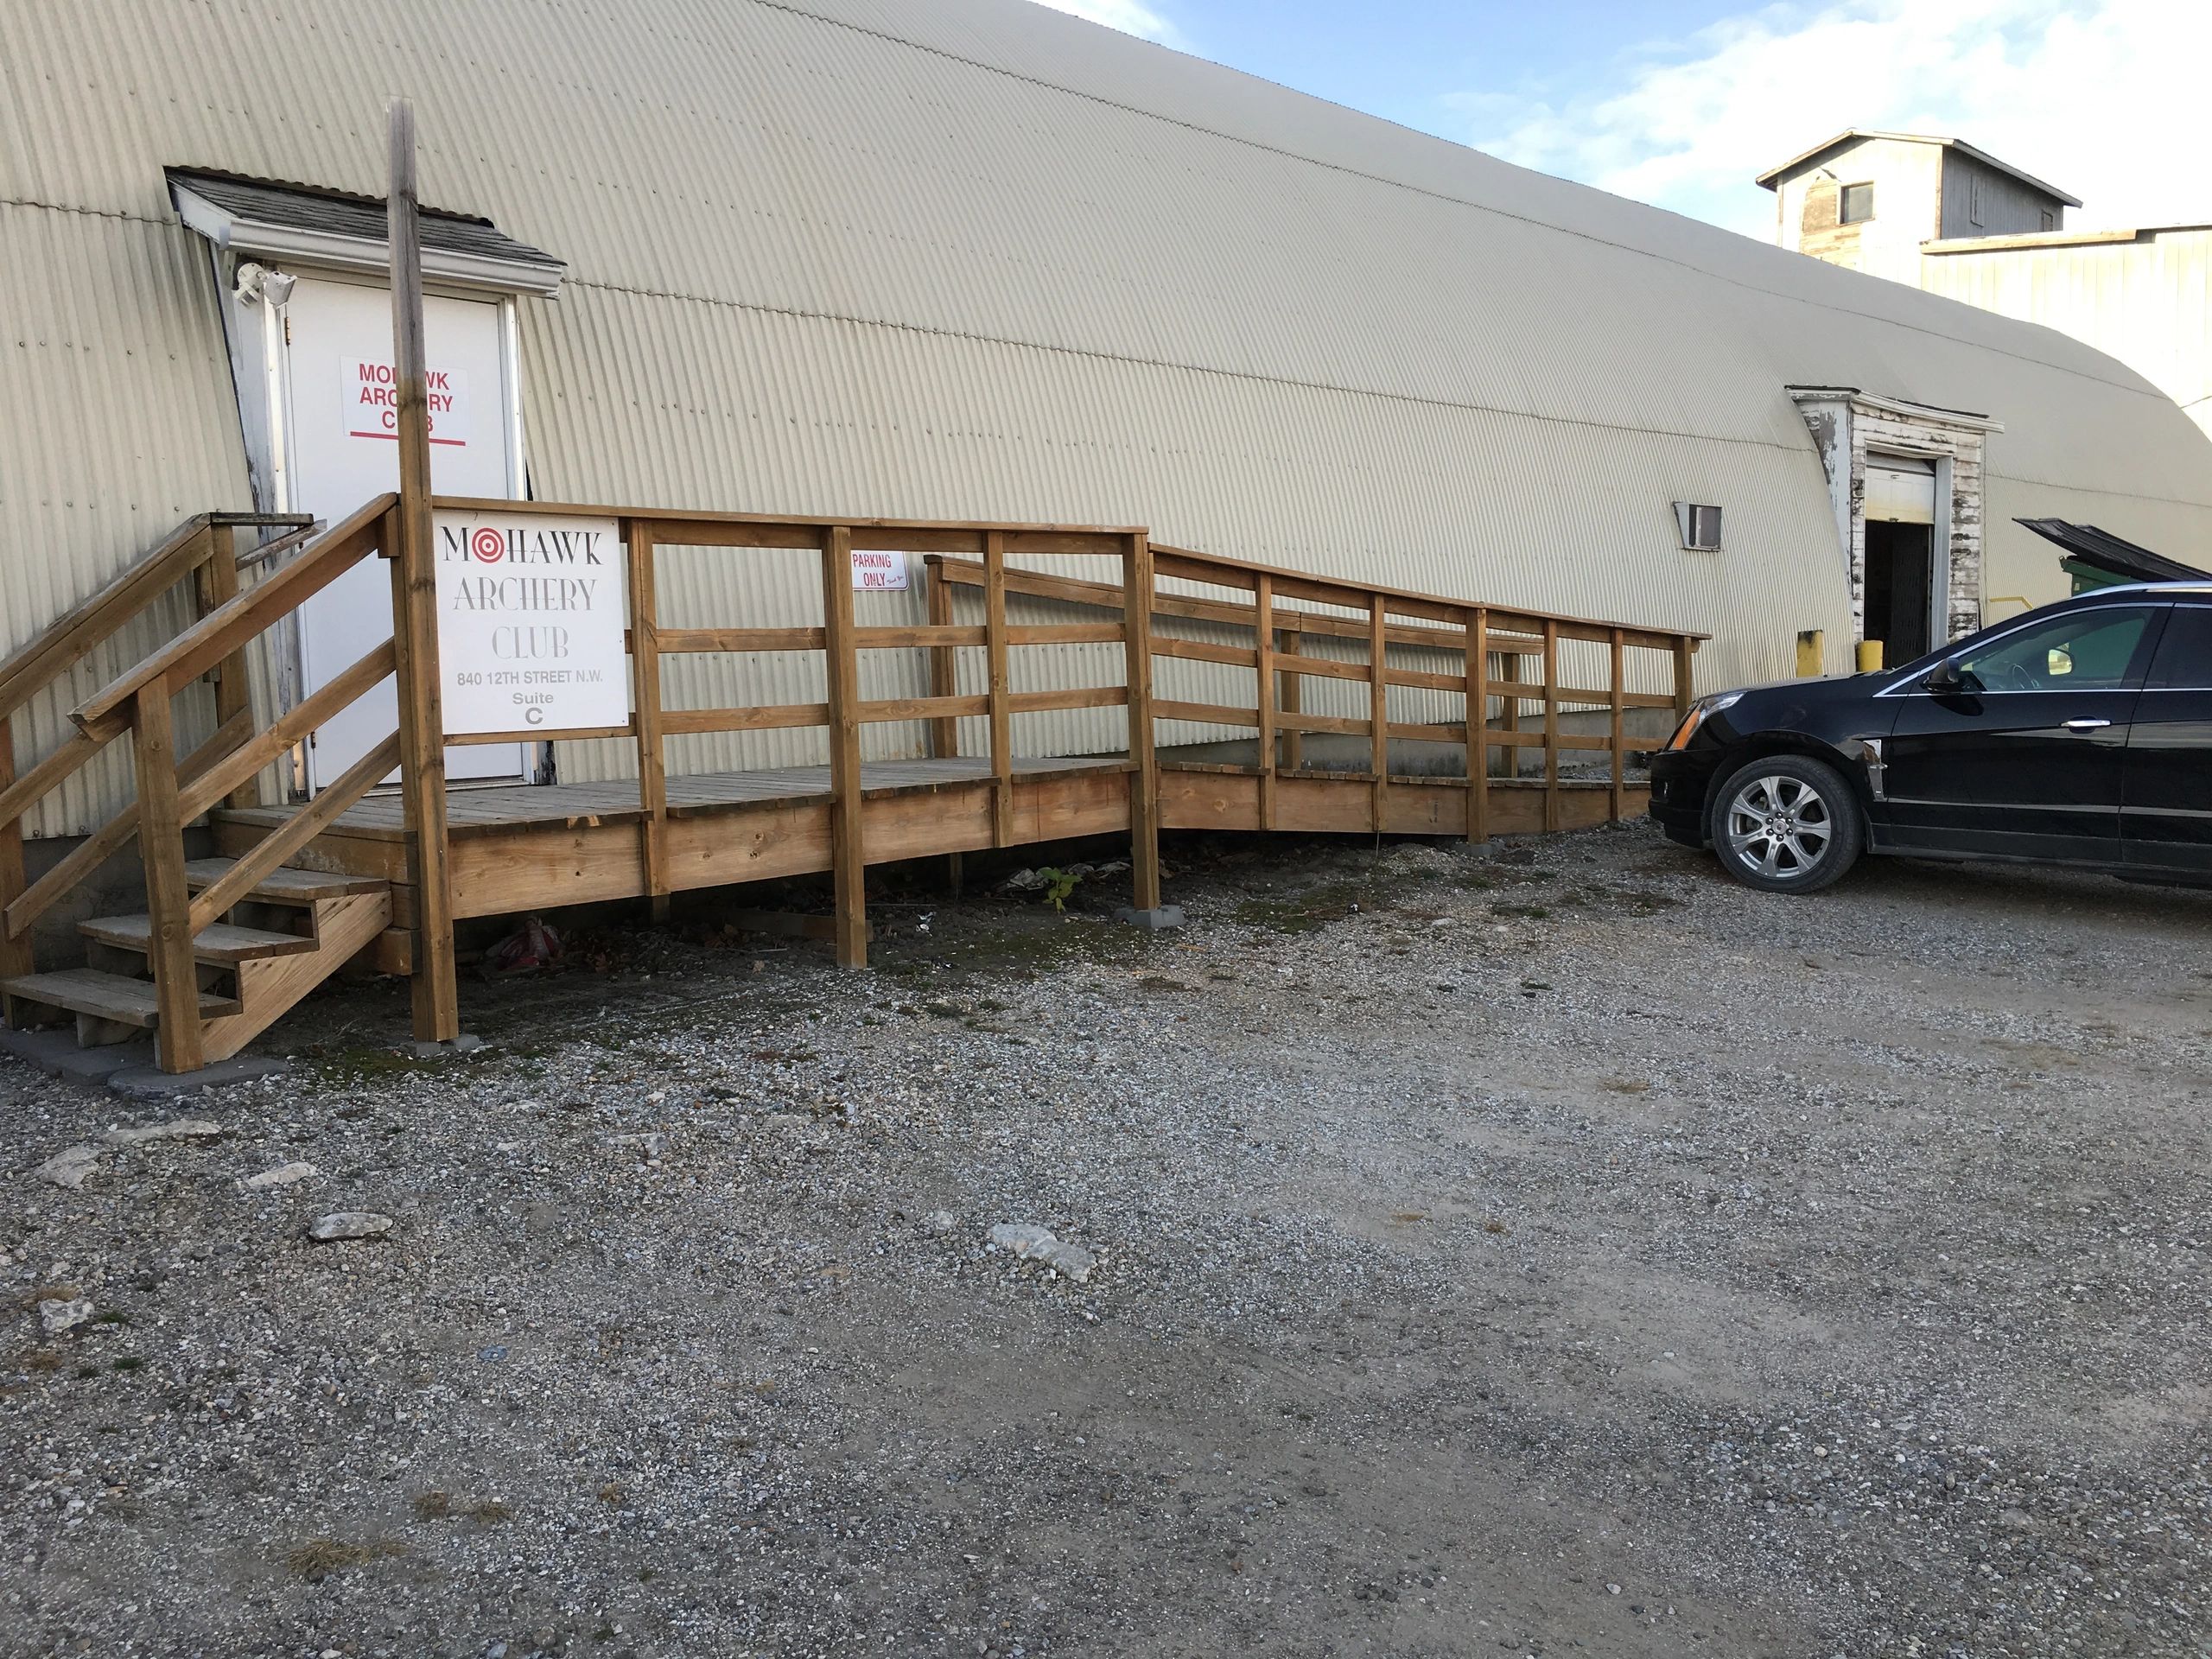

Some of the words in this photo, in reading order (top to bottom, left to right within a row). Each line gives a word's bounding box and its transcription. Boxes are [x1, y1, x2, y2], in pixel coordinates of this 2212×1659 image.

[440, 525, 603, 565] MOHAWK
[852, 554, 892, 568] PARKING
[863, 573, 885, 586] ONLY
[453, 576, 597, 611] ARCHERY
[492, 626, 569, 659] CLUB
[457, 672, 482, 686] 840
[487, 671, 519, 685] 12TH
[524, 671, 572, 684] STREET
[575, 670, 603, 683] N.W.
[512, 692, 554, 705] Suite
[524, 708, 543, 725] C
